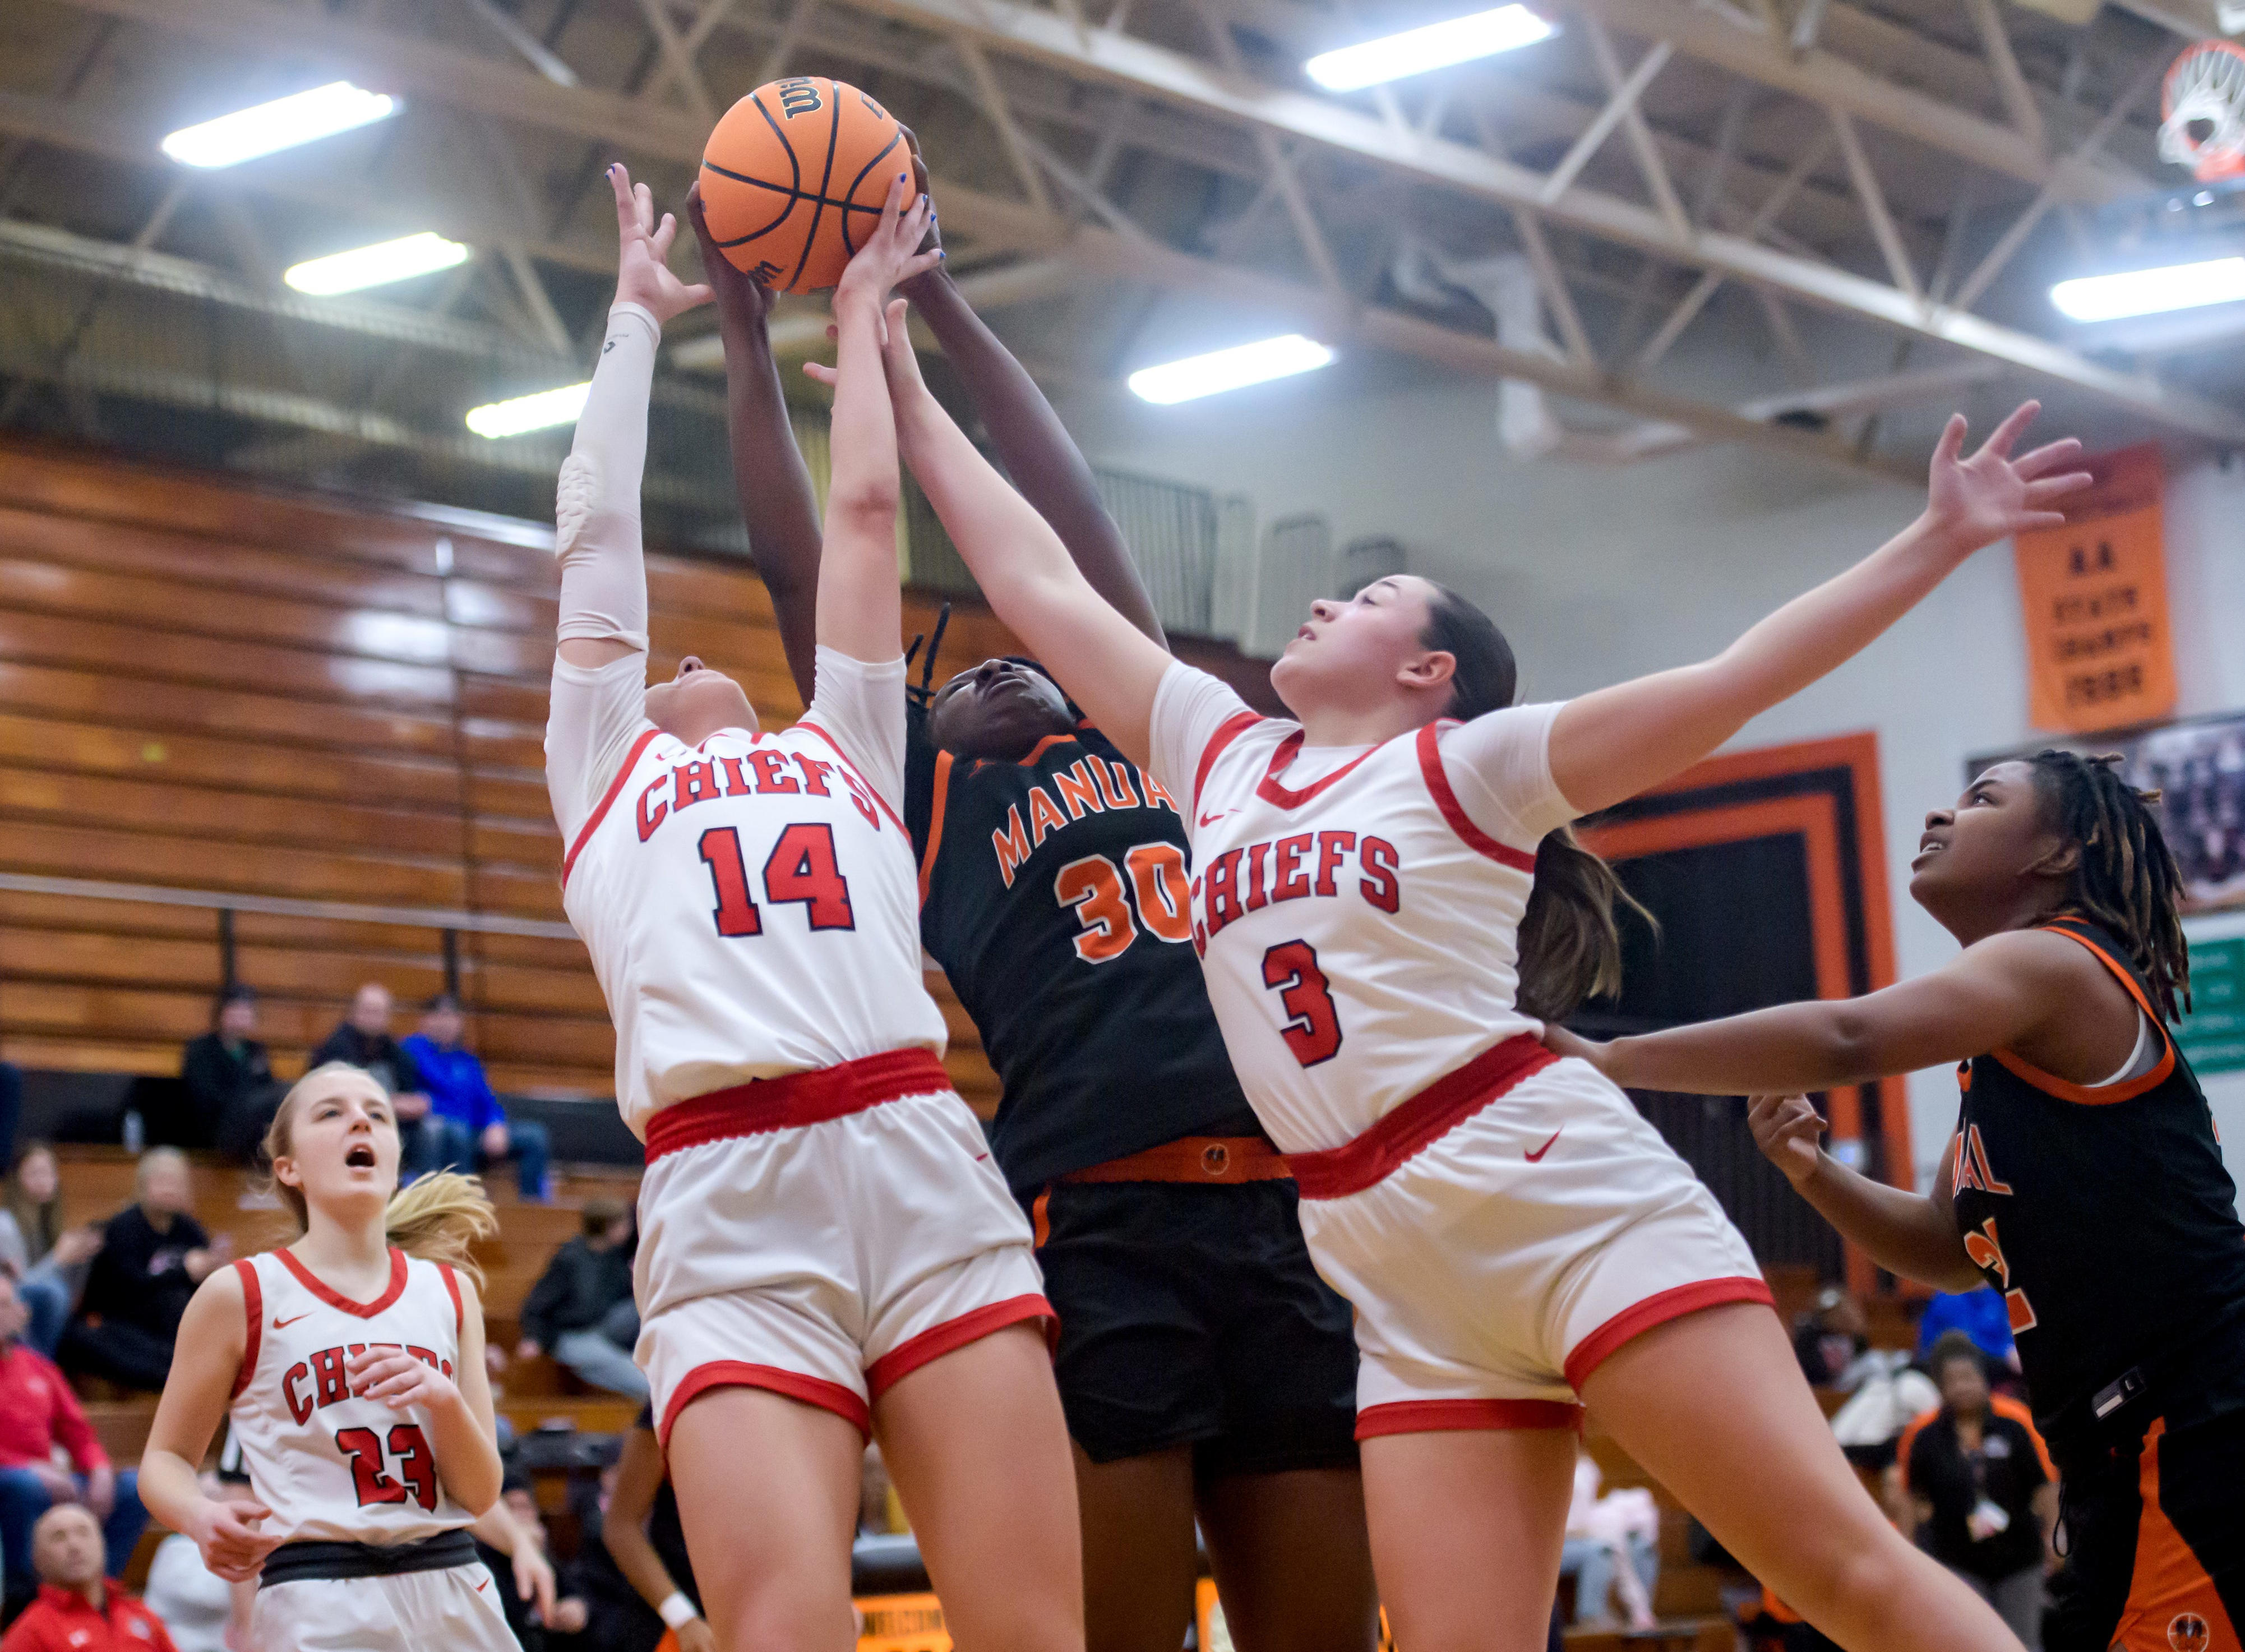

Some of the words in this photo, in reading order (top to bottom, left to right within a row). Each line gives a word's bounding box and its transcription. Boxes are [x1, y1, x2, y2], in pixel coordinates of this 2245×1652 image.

[636, 749, 880, 843] CHIEFS
[992, 755, 1180, 889] MANUA
[697, 823, 856, 937] 14
[1054, 841, 1193, 965] 30
[1261, 938, 1343, 1069] 3
[334, 1424, 438, 1515] 23
